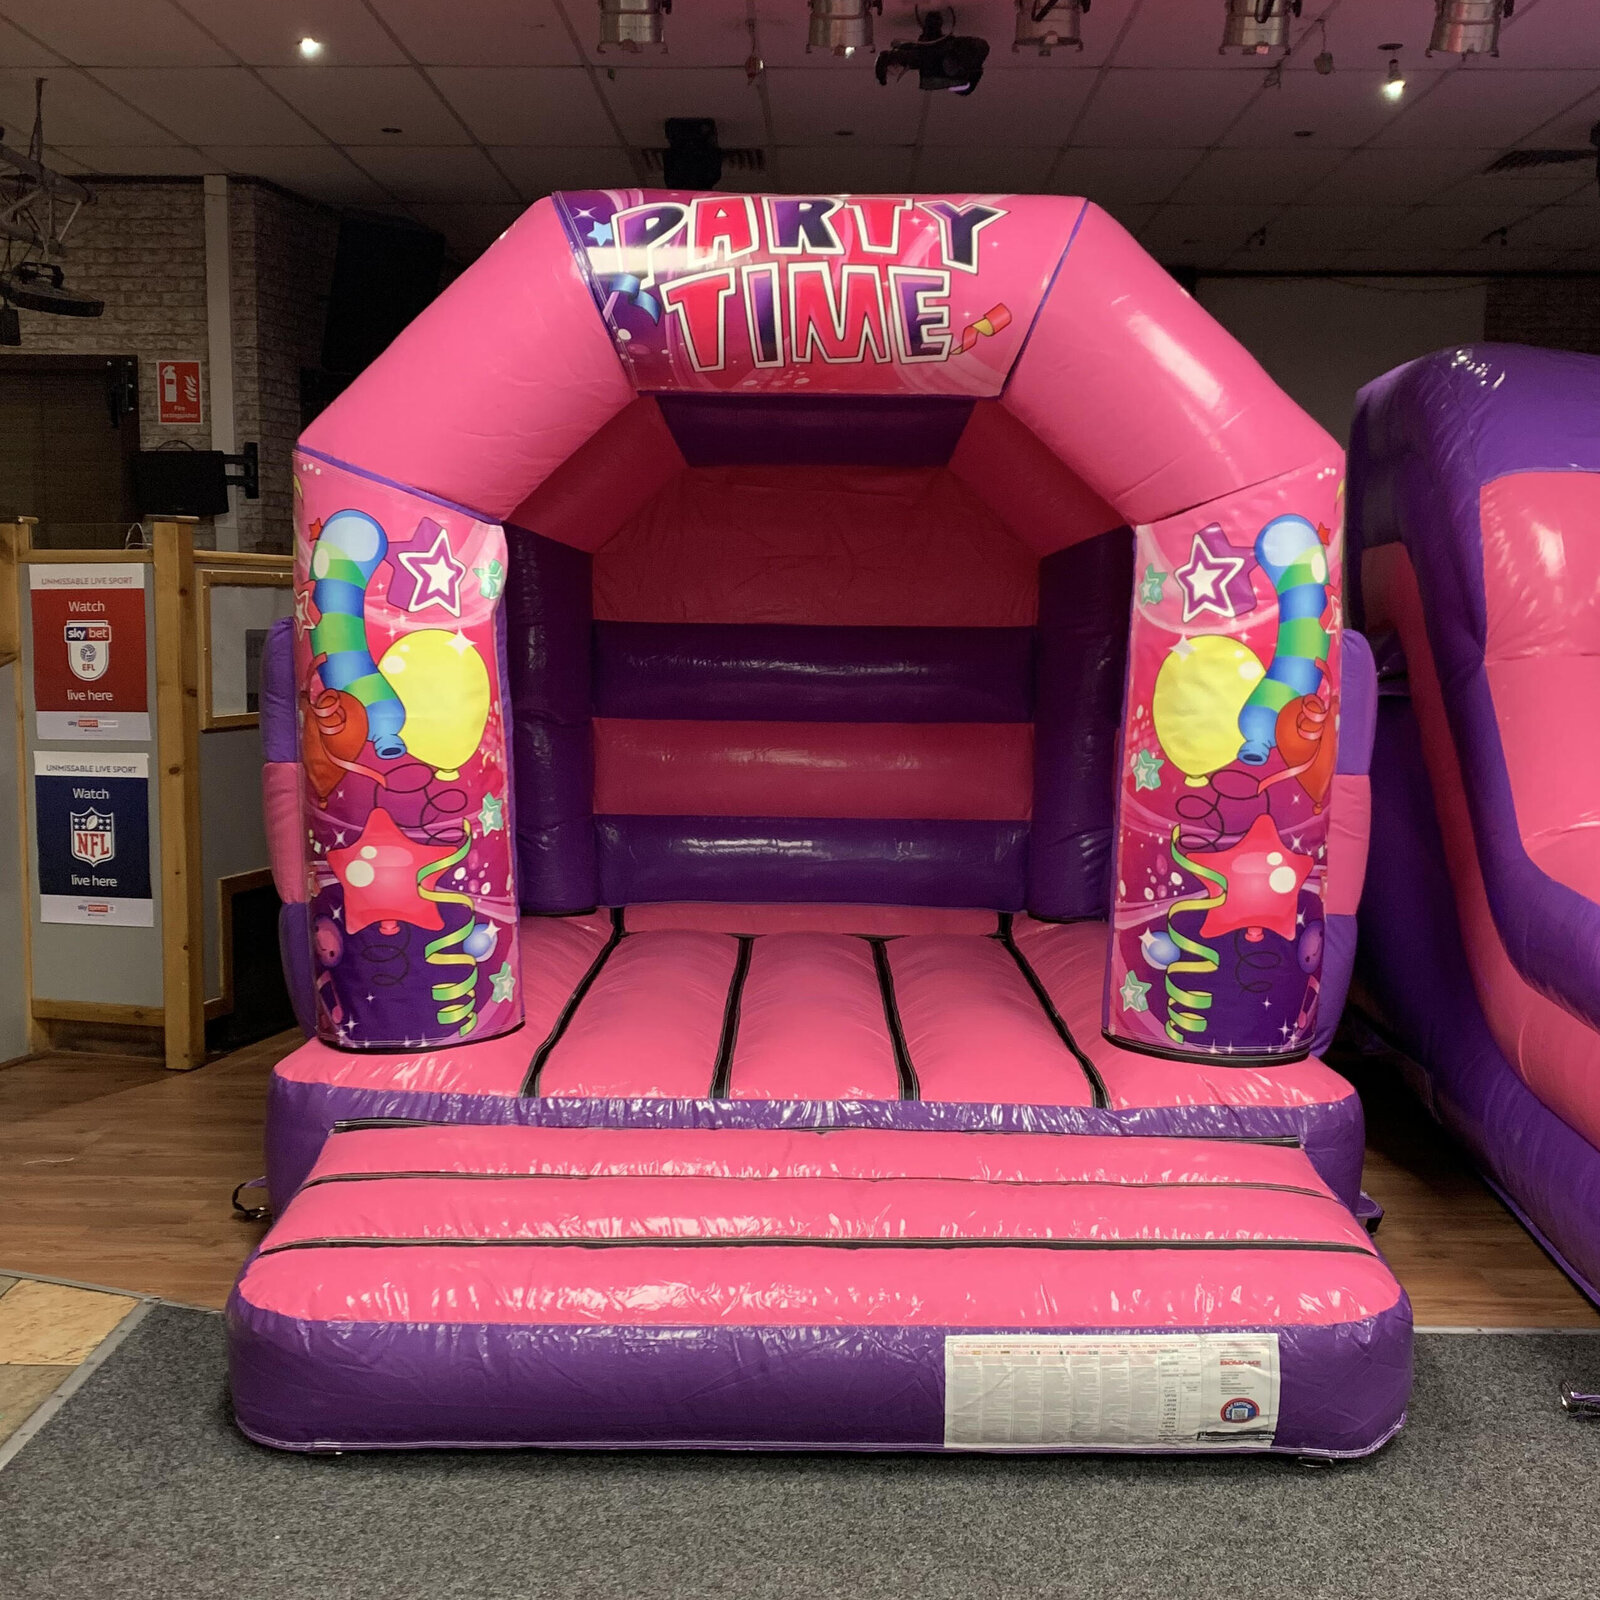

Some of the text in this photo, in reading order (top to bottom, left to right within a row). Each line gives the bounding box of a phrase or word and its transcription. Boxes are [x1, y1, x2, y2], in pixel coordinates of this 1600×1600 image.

[611, 196, 1009, 288] PARTY
[659, 261, 952, 372] TIME
[41, 576, 133, 585] UNMISSABLE LIVE SPORT
[68, 601, 105, 612] Watch
[67, 627, 108, 640] sky bet
[82, 663, 96, 671] EFL
[67, 690, 113, 701] live here
[46, 765, 93, 773] UNMISSABLE
[112, 766, 137, 774] SPORT
[73, 788, 109, 799] Watch
[76, 832, 109, 857] NFL
[71, 874, 118, 887] live here
